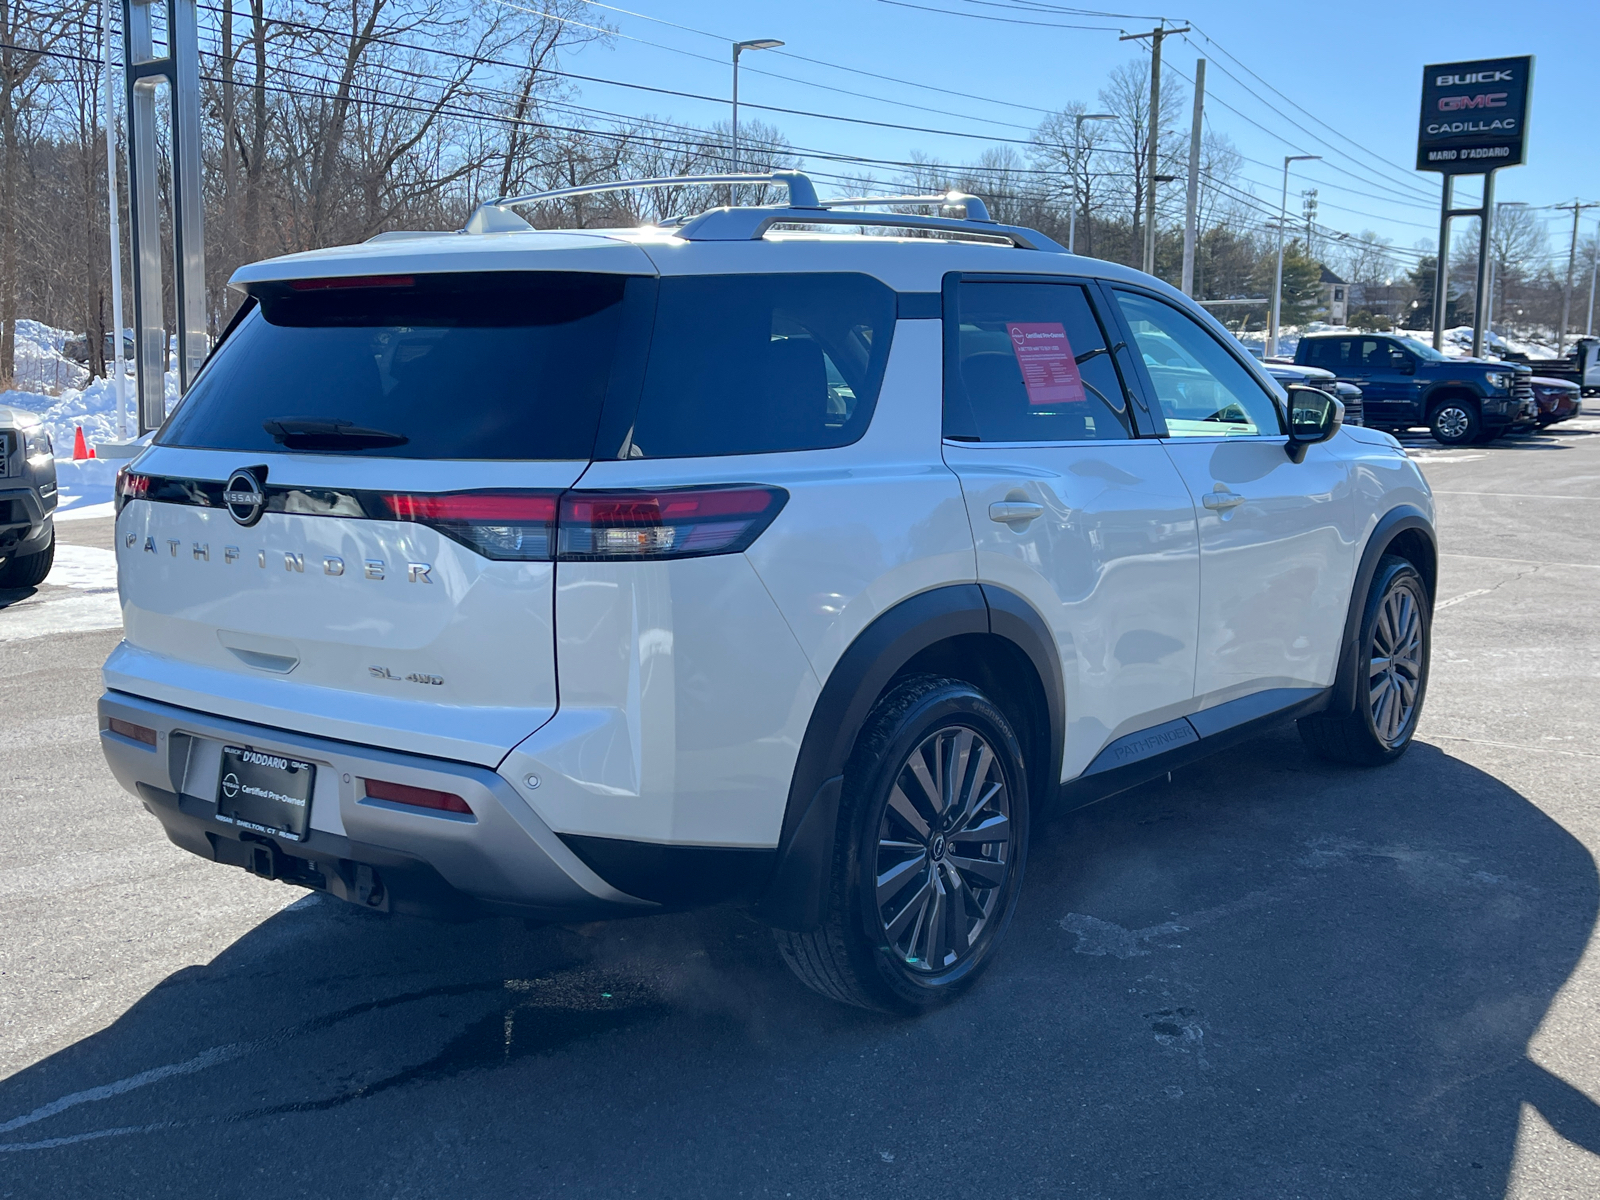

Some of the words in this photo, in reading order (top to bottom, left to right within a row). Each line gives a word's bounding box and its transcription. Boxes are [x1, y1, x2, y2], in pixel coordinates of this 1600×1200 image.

[1436, 70, 1513, 86] BUICK
[1438, 92, 1508, 111] GMC
[1427, 119, 1515, 134] CADILLAC
[1428, 150, 1457, 161] MARIO
[1460, 147, 1510, 159] D'ADDARIO
[223, 493, 261, 503] NISSAN
[125, 531, 434, 584] PATHFINDER
[368, 665, 401, 681] SL
[405, 672, 444, 686] 4WD
[1113, 725, 1193, 760] PATHFINDER
[224, 746, 242, 755] BUICK
[242, 751, 288, 770] D'ADDARIO
[291, 761, 309, 770] GMC
[241, 785, 268, 798] Certified
[268, 791, 306, 807] Pre-Owned
[266, 827, 276, 835] CT
